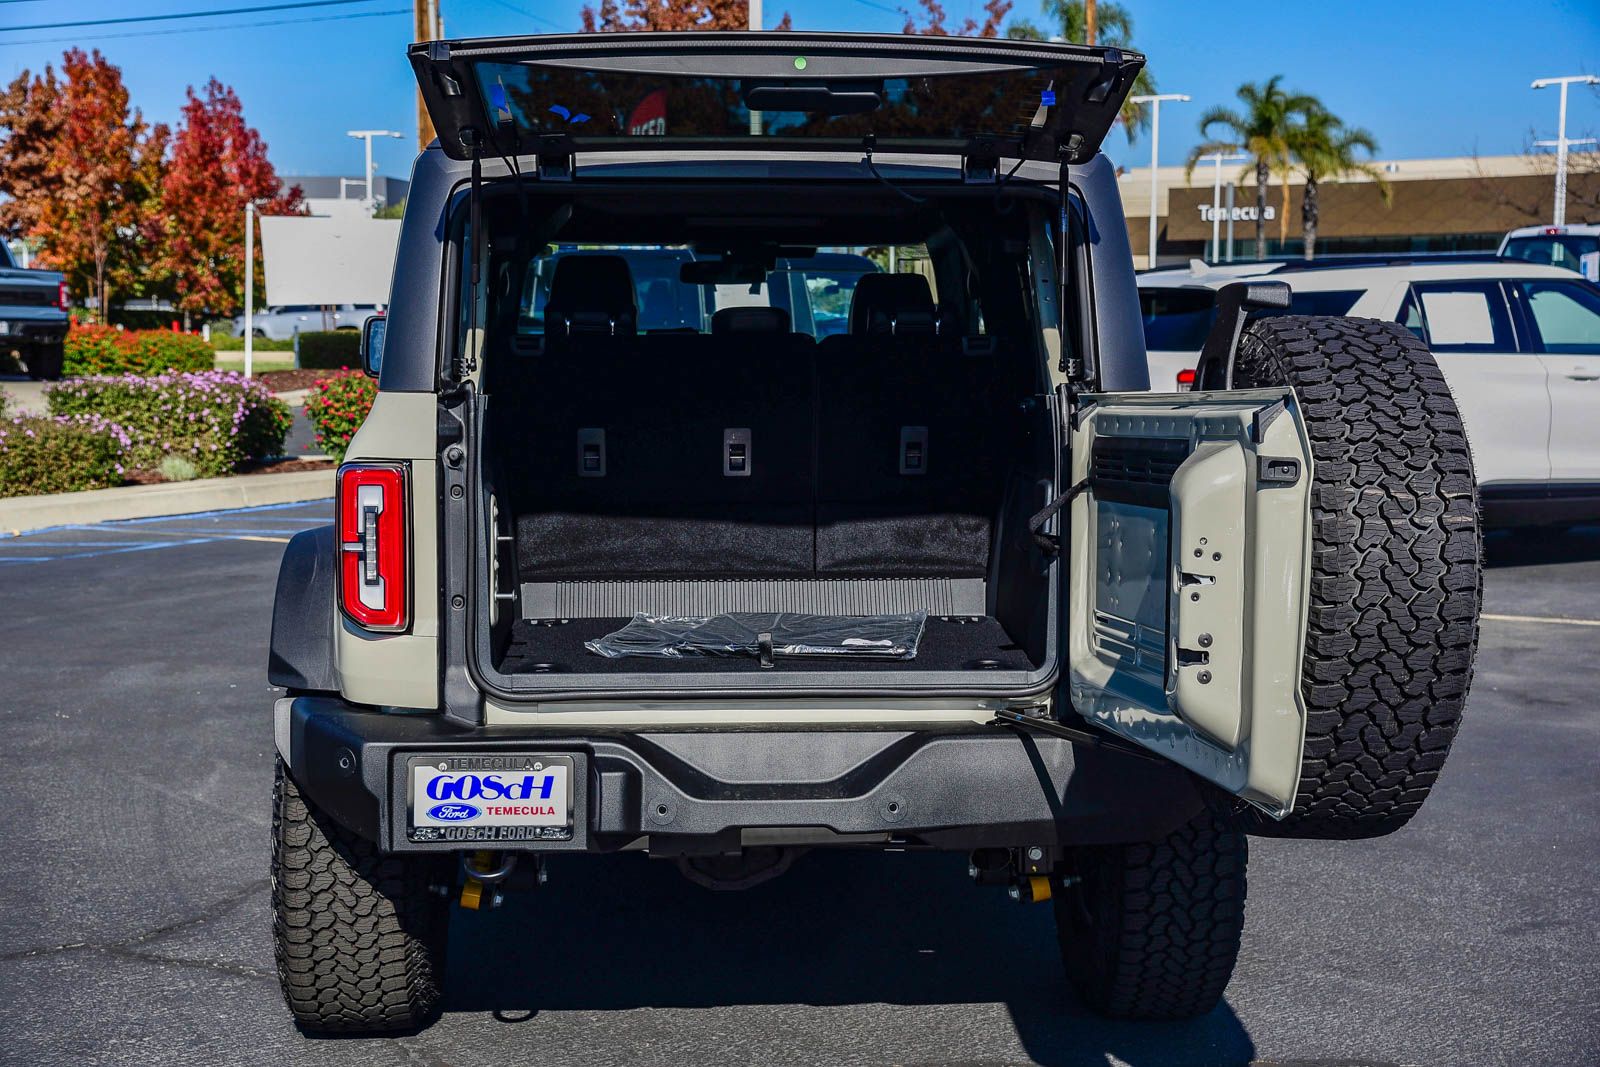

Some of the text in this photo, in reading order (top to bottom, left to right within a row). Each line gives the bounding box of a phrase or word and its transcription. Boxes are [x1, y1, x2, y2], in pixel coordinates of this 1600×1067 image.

[1197, 204, 1275, 221] Temecua
[448, 757, 534, 771] TEMECULA
[486, 806, 555, 816] TEMECULA
[499, 827, 535, 840] FORD
